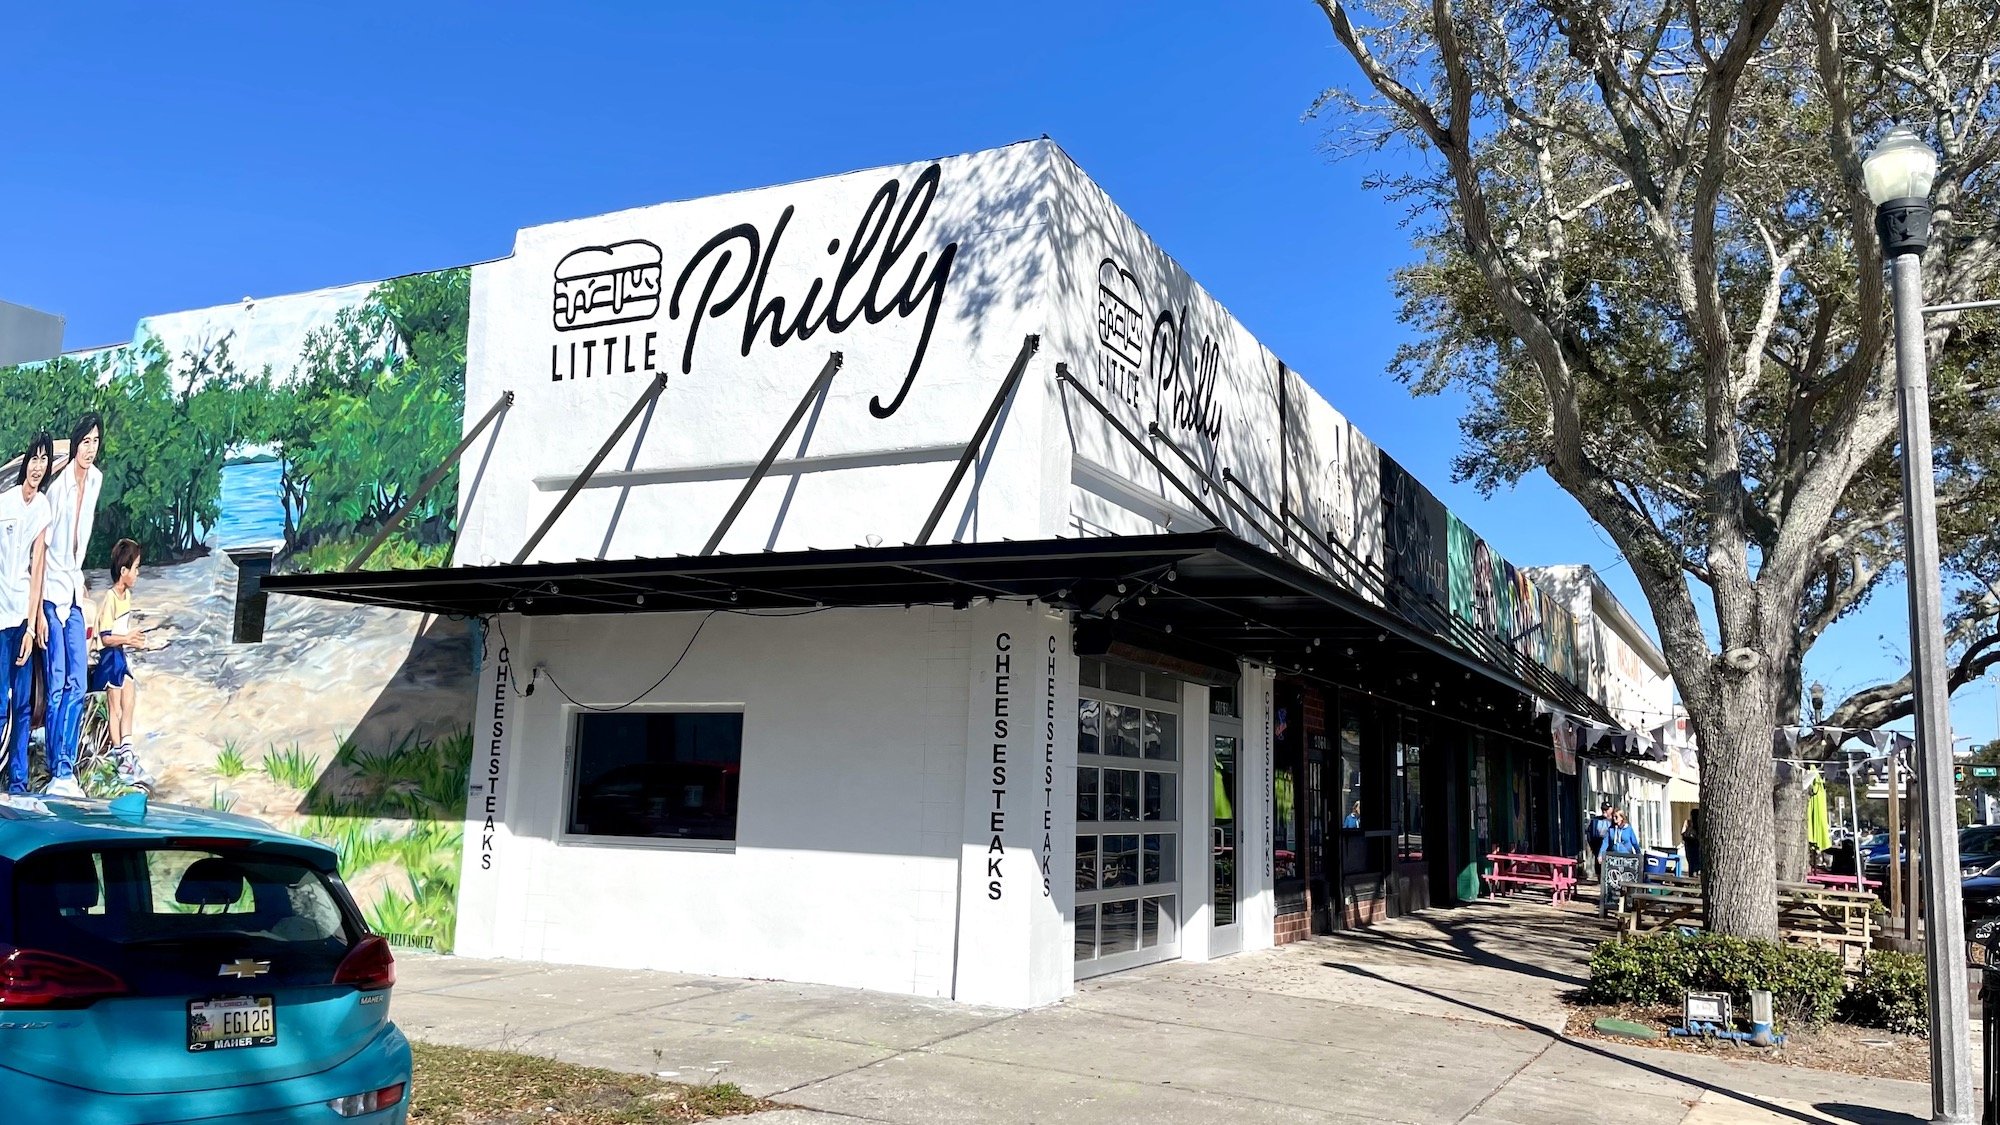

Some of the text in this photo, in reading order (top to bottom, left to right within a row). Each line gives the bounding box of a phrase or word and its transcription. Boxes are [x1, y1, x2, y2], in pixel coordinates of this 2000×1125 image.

[669, 164, 958, 419] Philly
[552, 331, 657, 382] LITTLE
[1098, 349, 1140, 410] LITTLE
[1150, 305, 1222, 496] Philly
[481, 647, 509, 870] CHEESESTEAKS
[988, 632, 1011, 900] CHEESESTEAKS
[1042, 635, 1056, 898] CHEESESTEAKS
[214, 1037, 253, 1049] MAHER
[224, 1009, 270, 1035] EG12G
[360, 995, 384, 1005] MAHER
